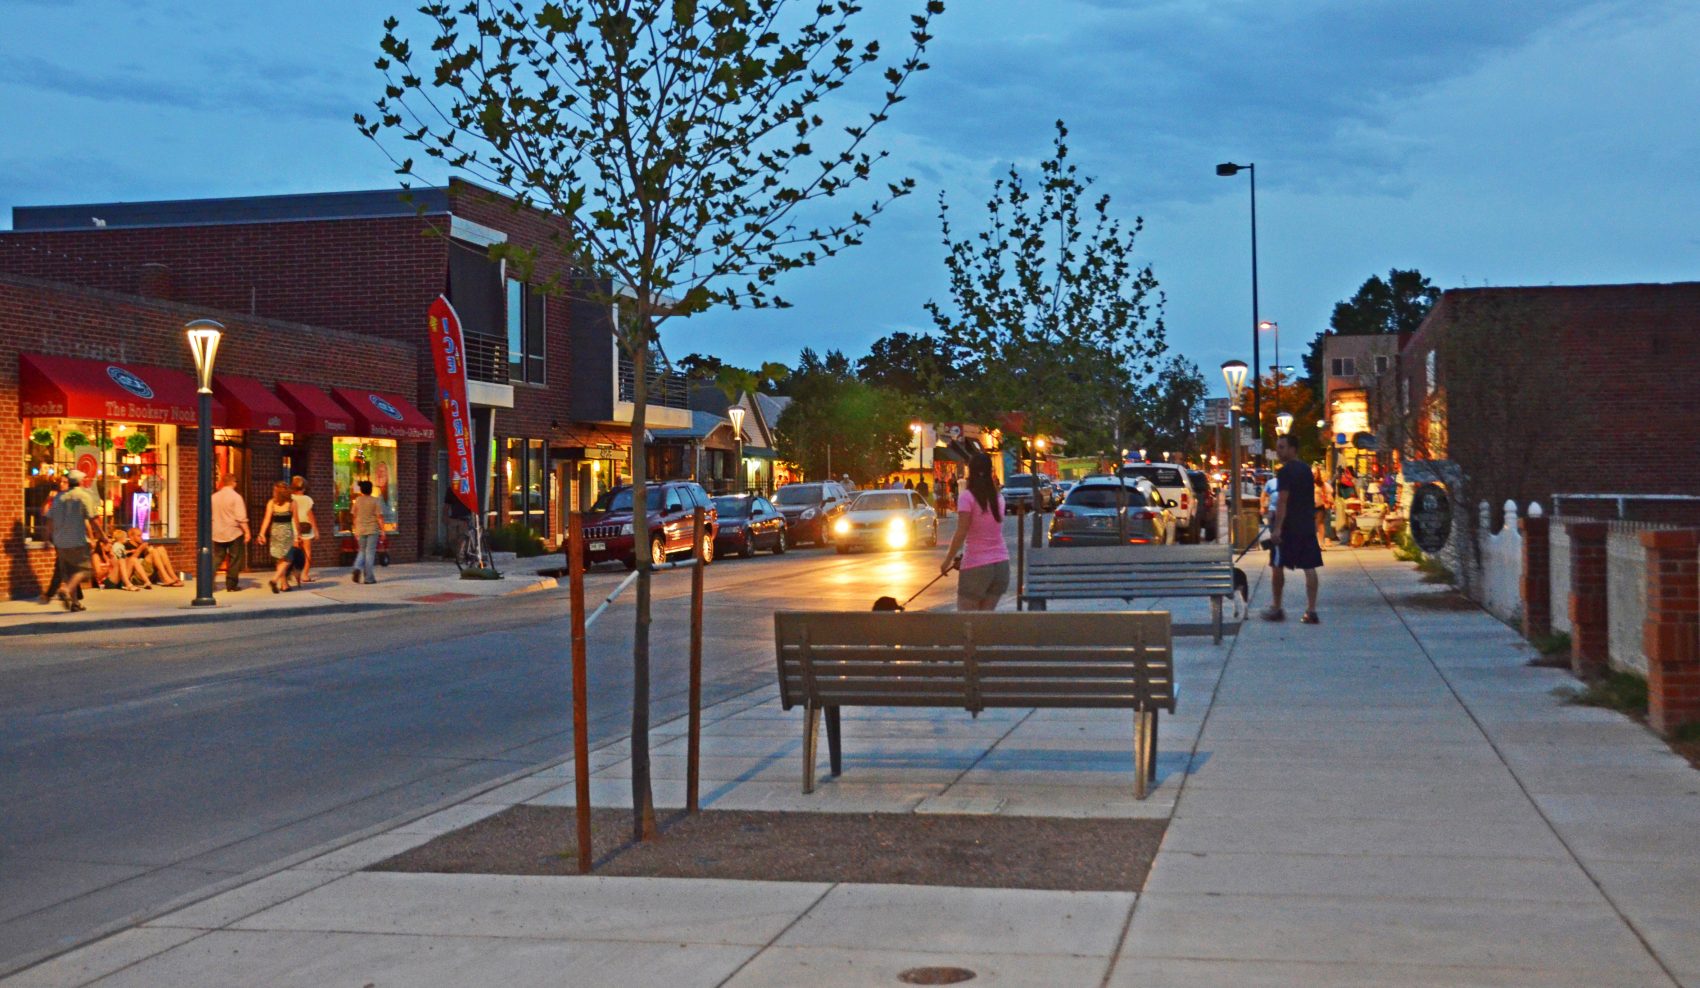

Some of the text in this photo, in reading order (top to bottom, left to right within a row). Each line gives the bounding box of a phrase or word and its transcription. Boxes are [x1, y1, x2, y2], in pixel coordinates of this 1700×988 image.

[22, 401, 64, 415] Books
[105, 400, 196, 422] The Bookery Nook
